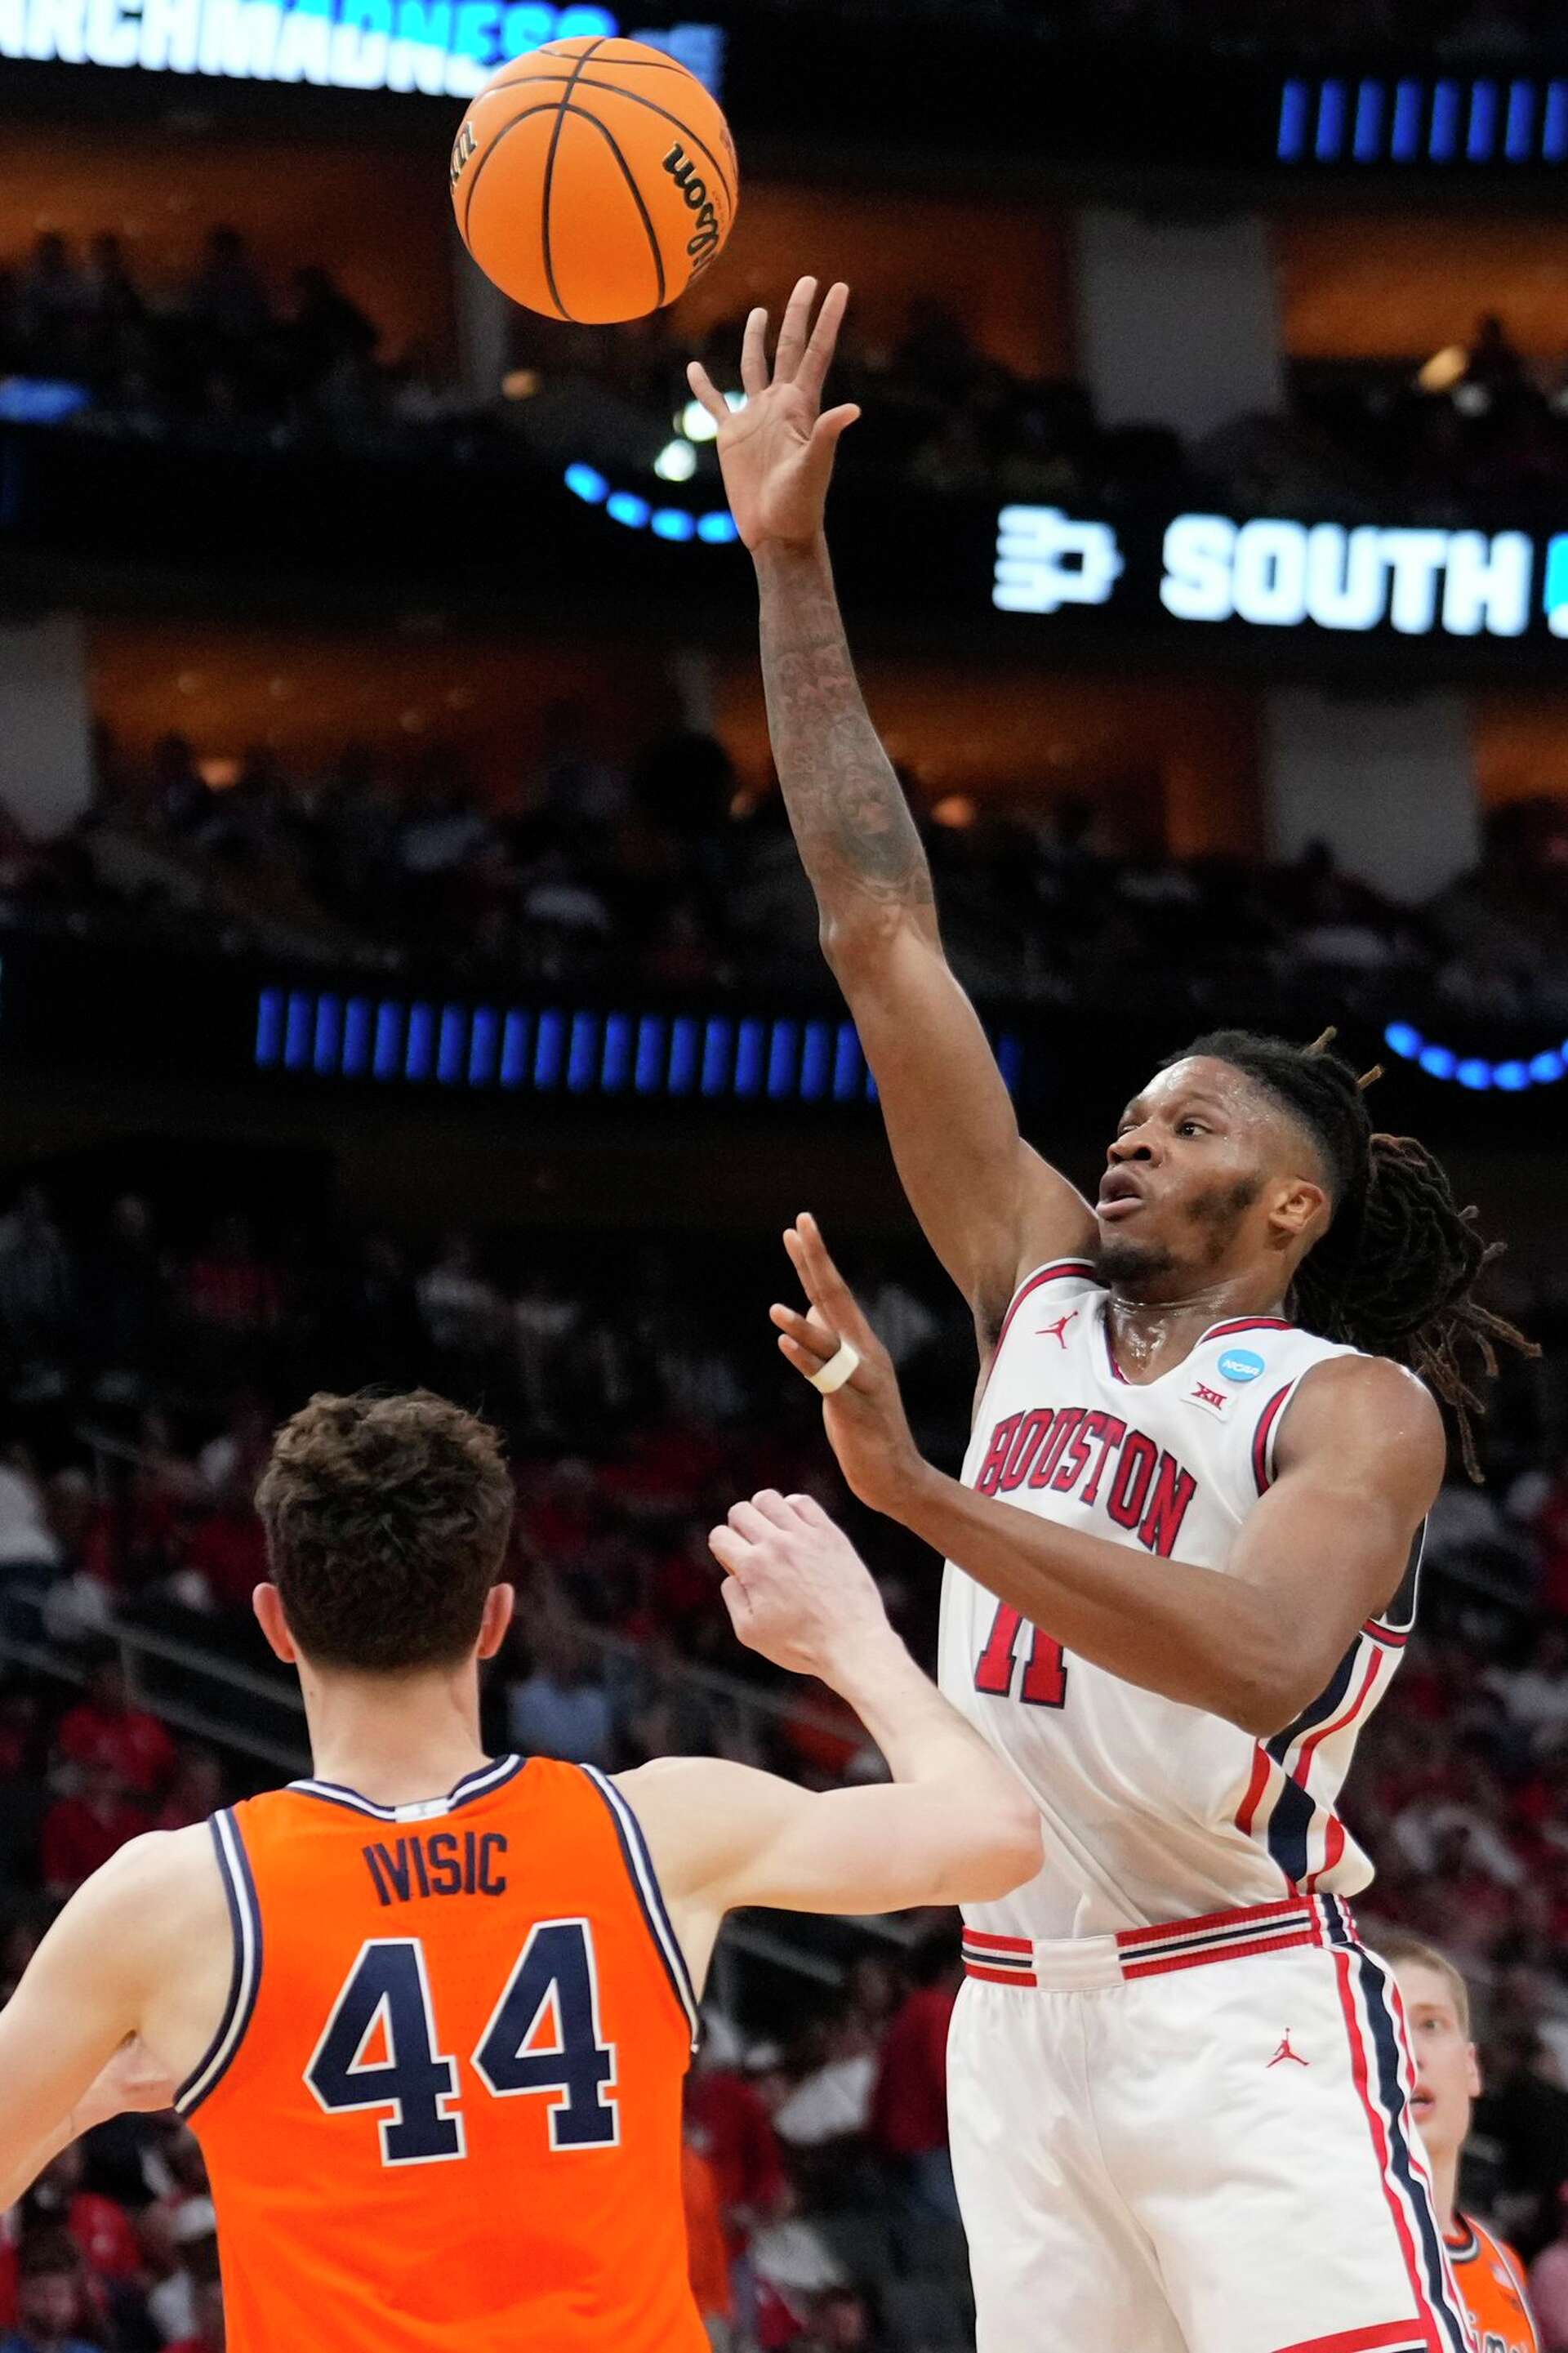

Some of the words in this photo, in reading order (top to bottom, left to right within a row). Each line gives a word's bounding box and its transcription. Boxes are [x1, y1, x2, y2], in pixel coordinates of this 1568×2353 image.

[1160, 513, 1533, 636] SOUTH
[975, 1406, 1198, 1558] HOUSTON
[361, 1832, 508, 1906] IVISIC
[301, 1917, 621, 2167] 44
